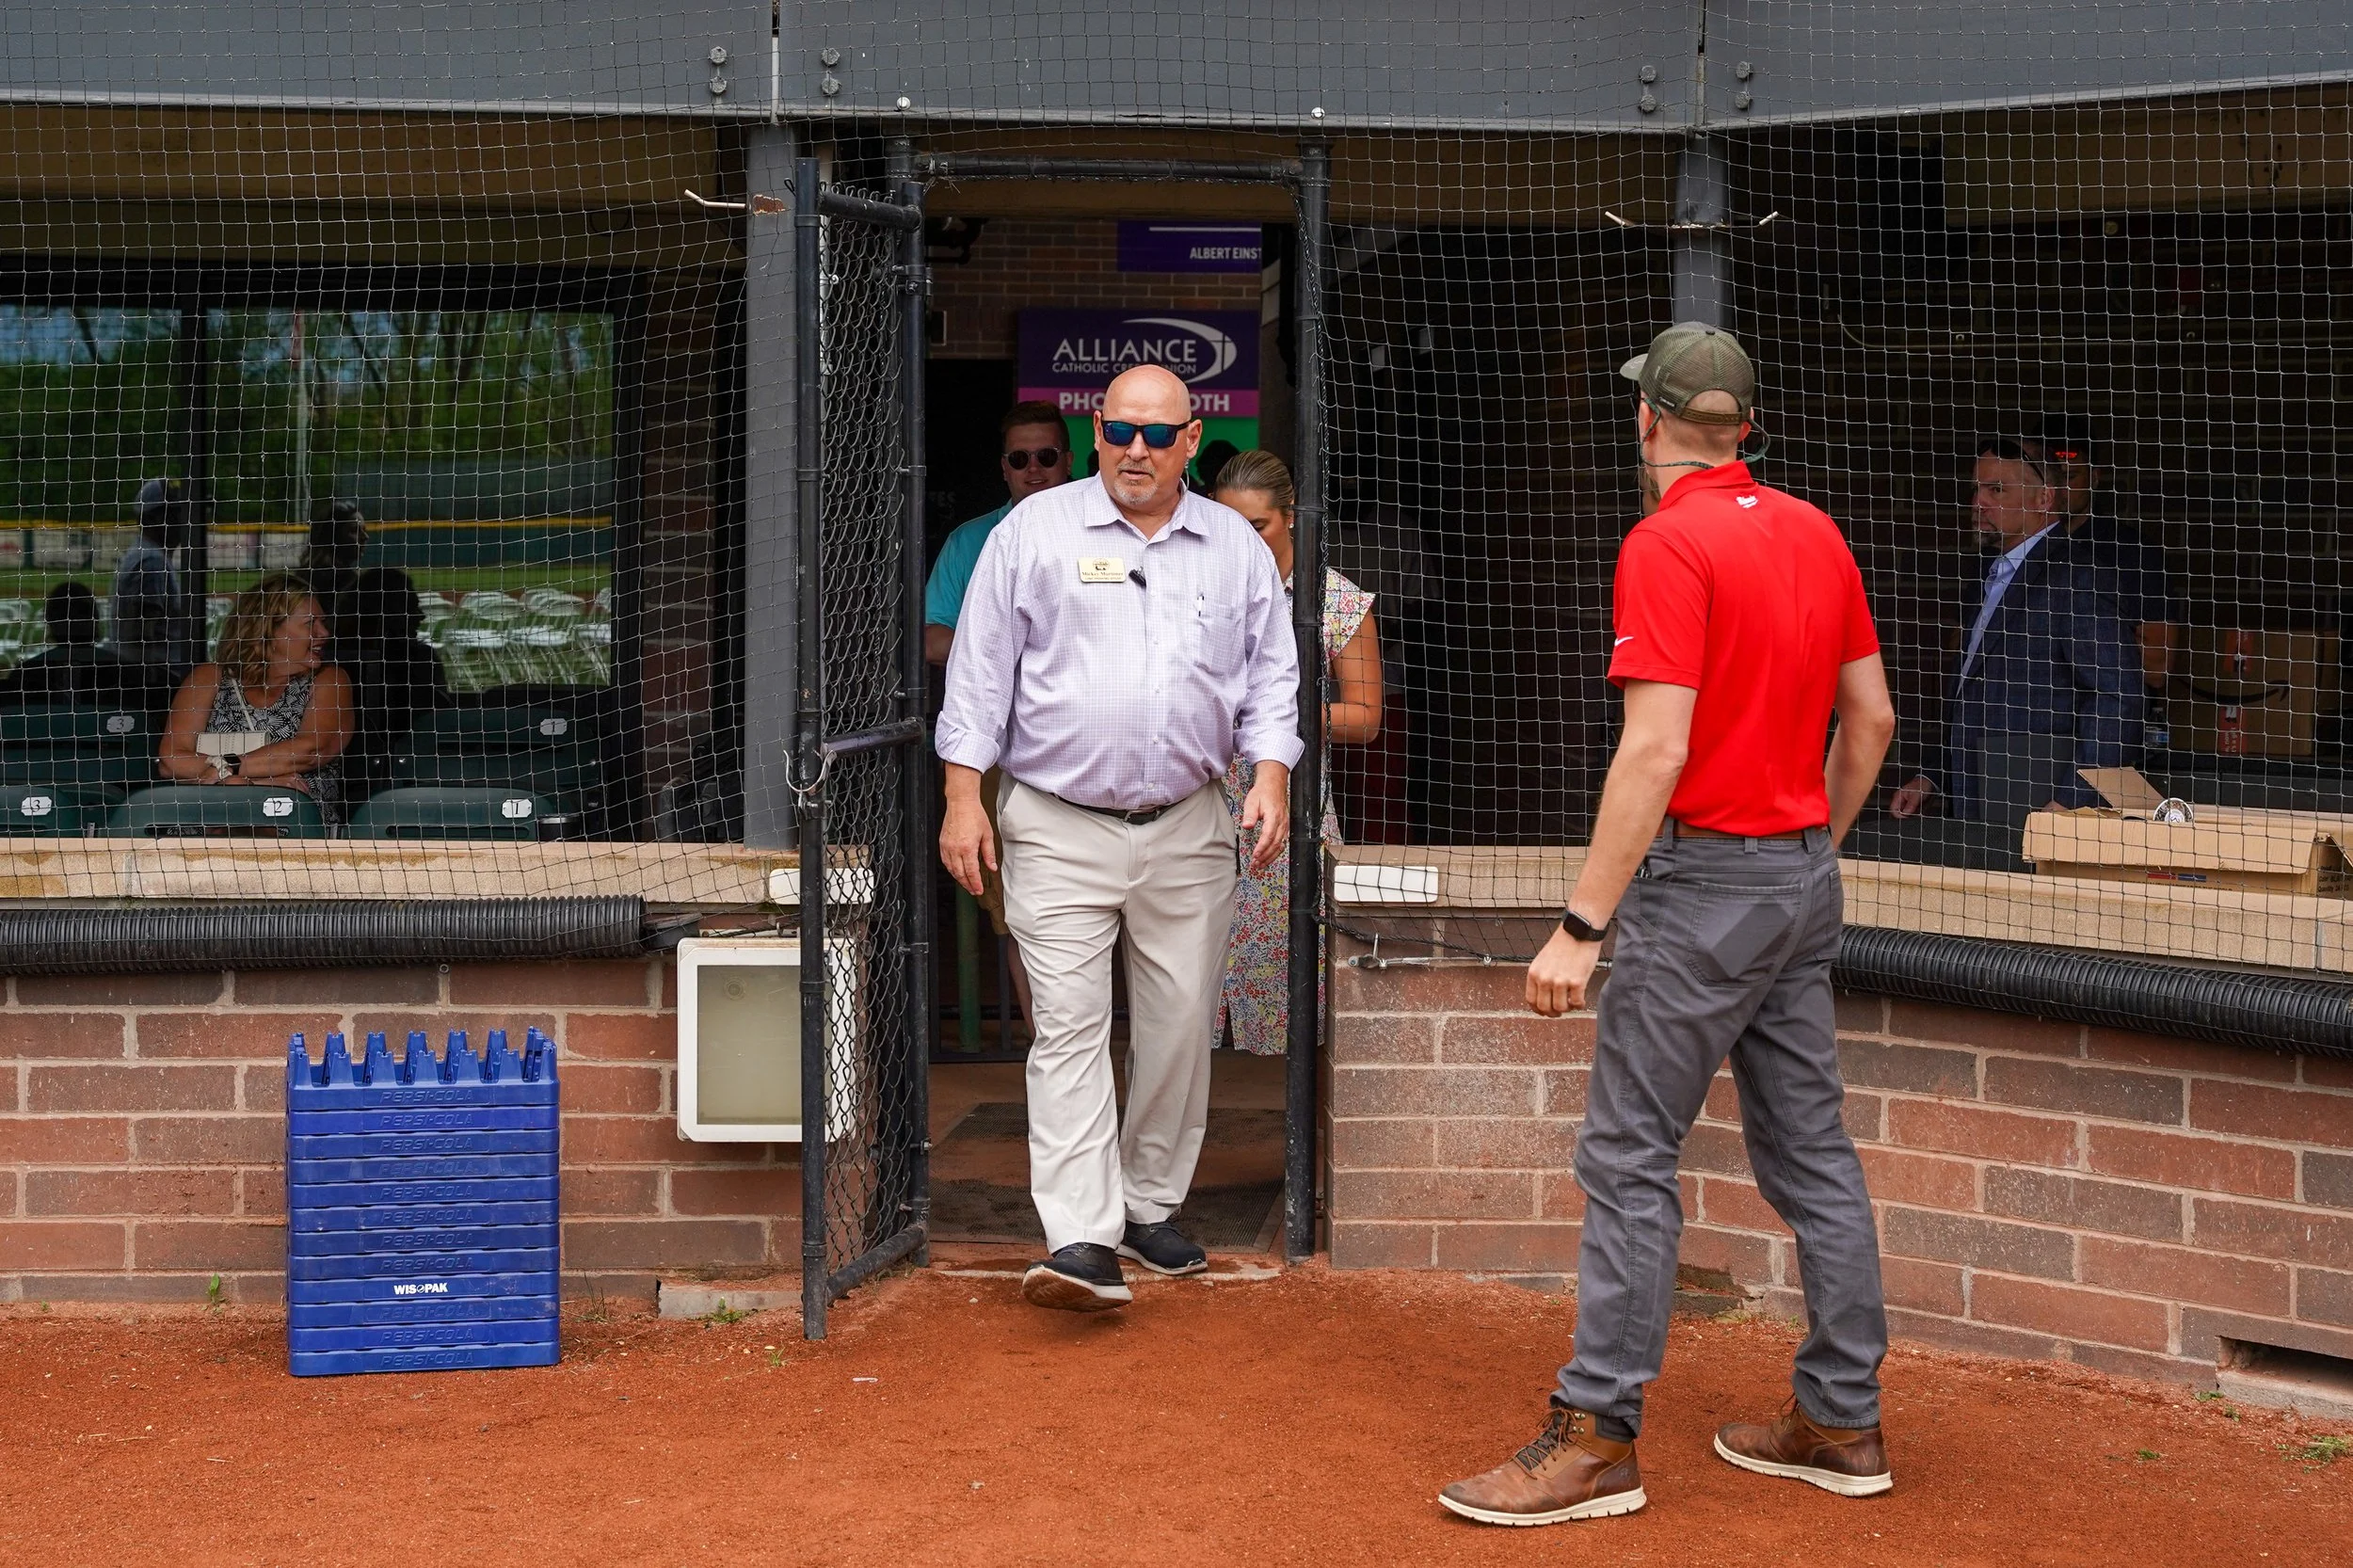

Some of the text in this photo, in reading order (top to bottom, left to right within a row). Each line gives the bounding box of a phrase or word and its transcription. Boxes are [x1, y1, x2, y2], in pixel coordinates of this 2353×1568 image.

[1190, 247, 1231, 260] ALBERT
[1052, 338, 1197, 363] ALLIANCE
[1051, 361, 1109, 374] CATHOLIC
[1164, 363, 1197, 375] NION
[1190, 392, 1230, 412] OTH
[116, 718, 124, 730] 3
[31, 799, 40, 812] 3
[273, 800, 282, 813] 2
[379, 1089, 474, 1103] PEPSI-COLA
[379, 1113, 474, 1127] PEPSI-COLA
[379, 1137, 474, 1151] PEPSI-COLA
[379, 1185, 474, 1199] PEPSI-COLA
[379, 1208, 474, 1223] PEPSI-COLA
[379, 1233, 474, 1247] PEPSI-COLA
[379, 1256, 474, 1271] PEPSI-COLA
[379, 1328, 474, 1343] PEPSI-COLA
[379, 1352, 474, 1366] PEPSI-COLA
